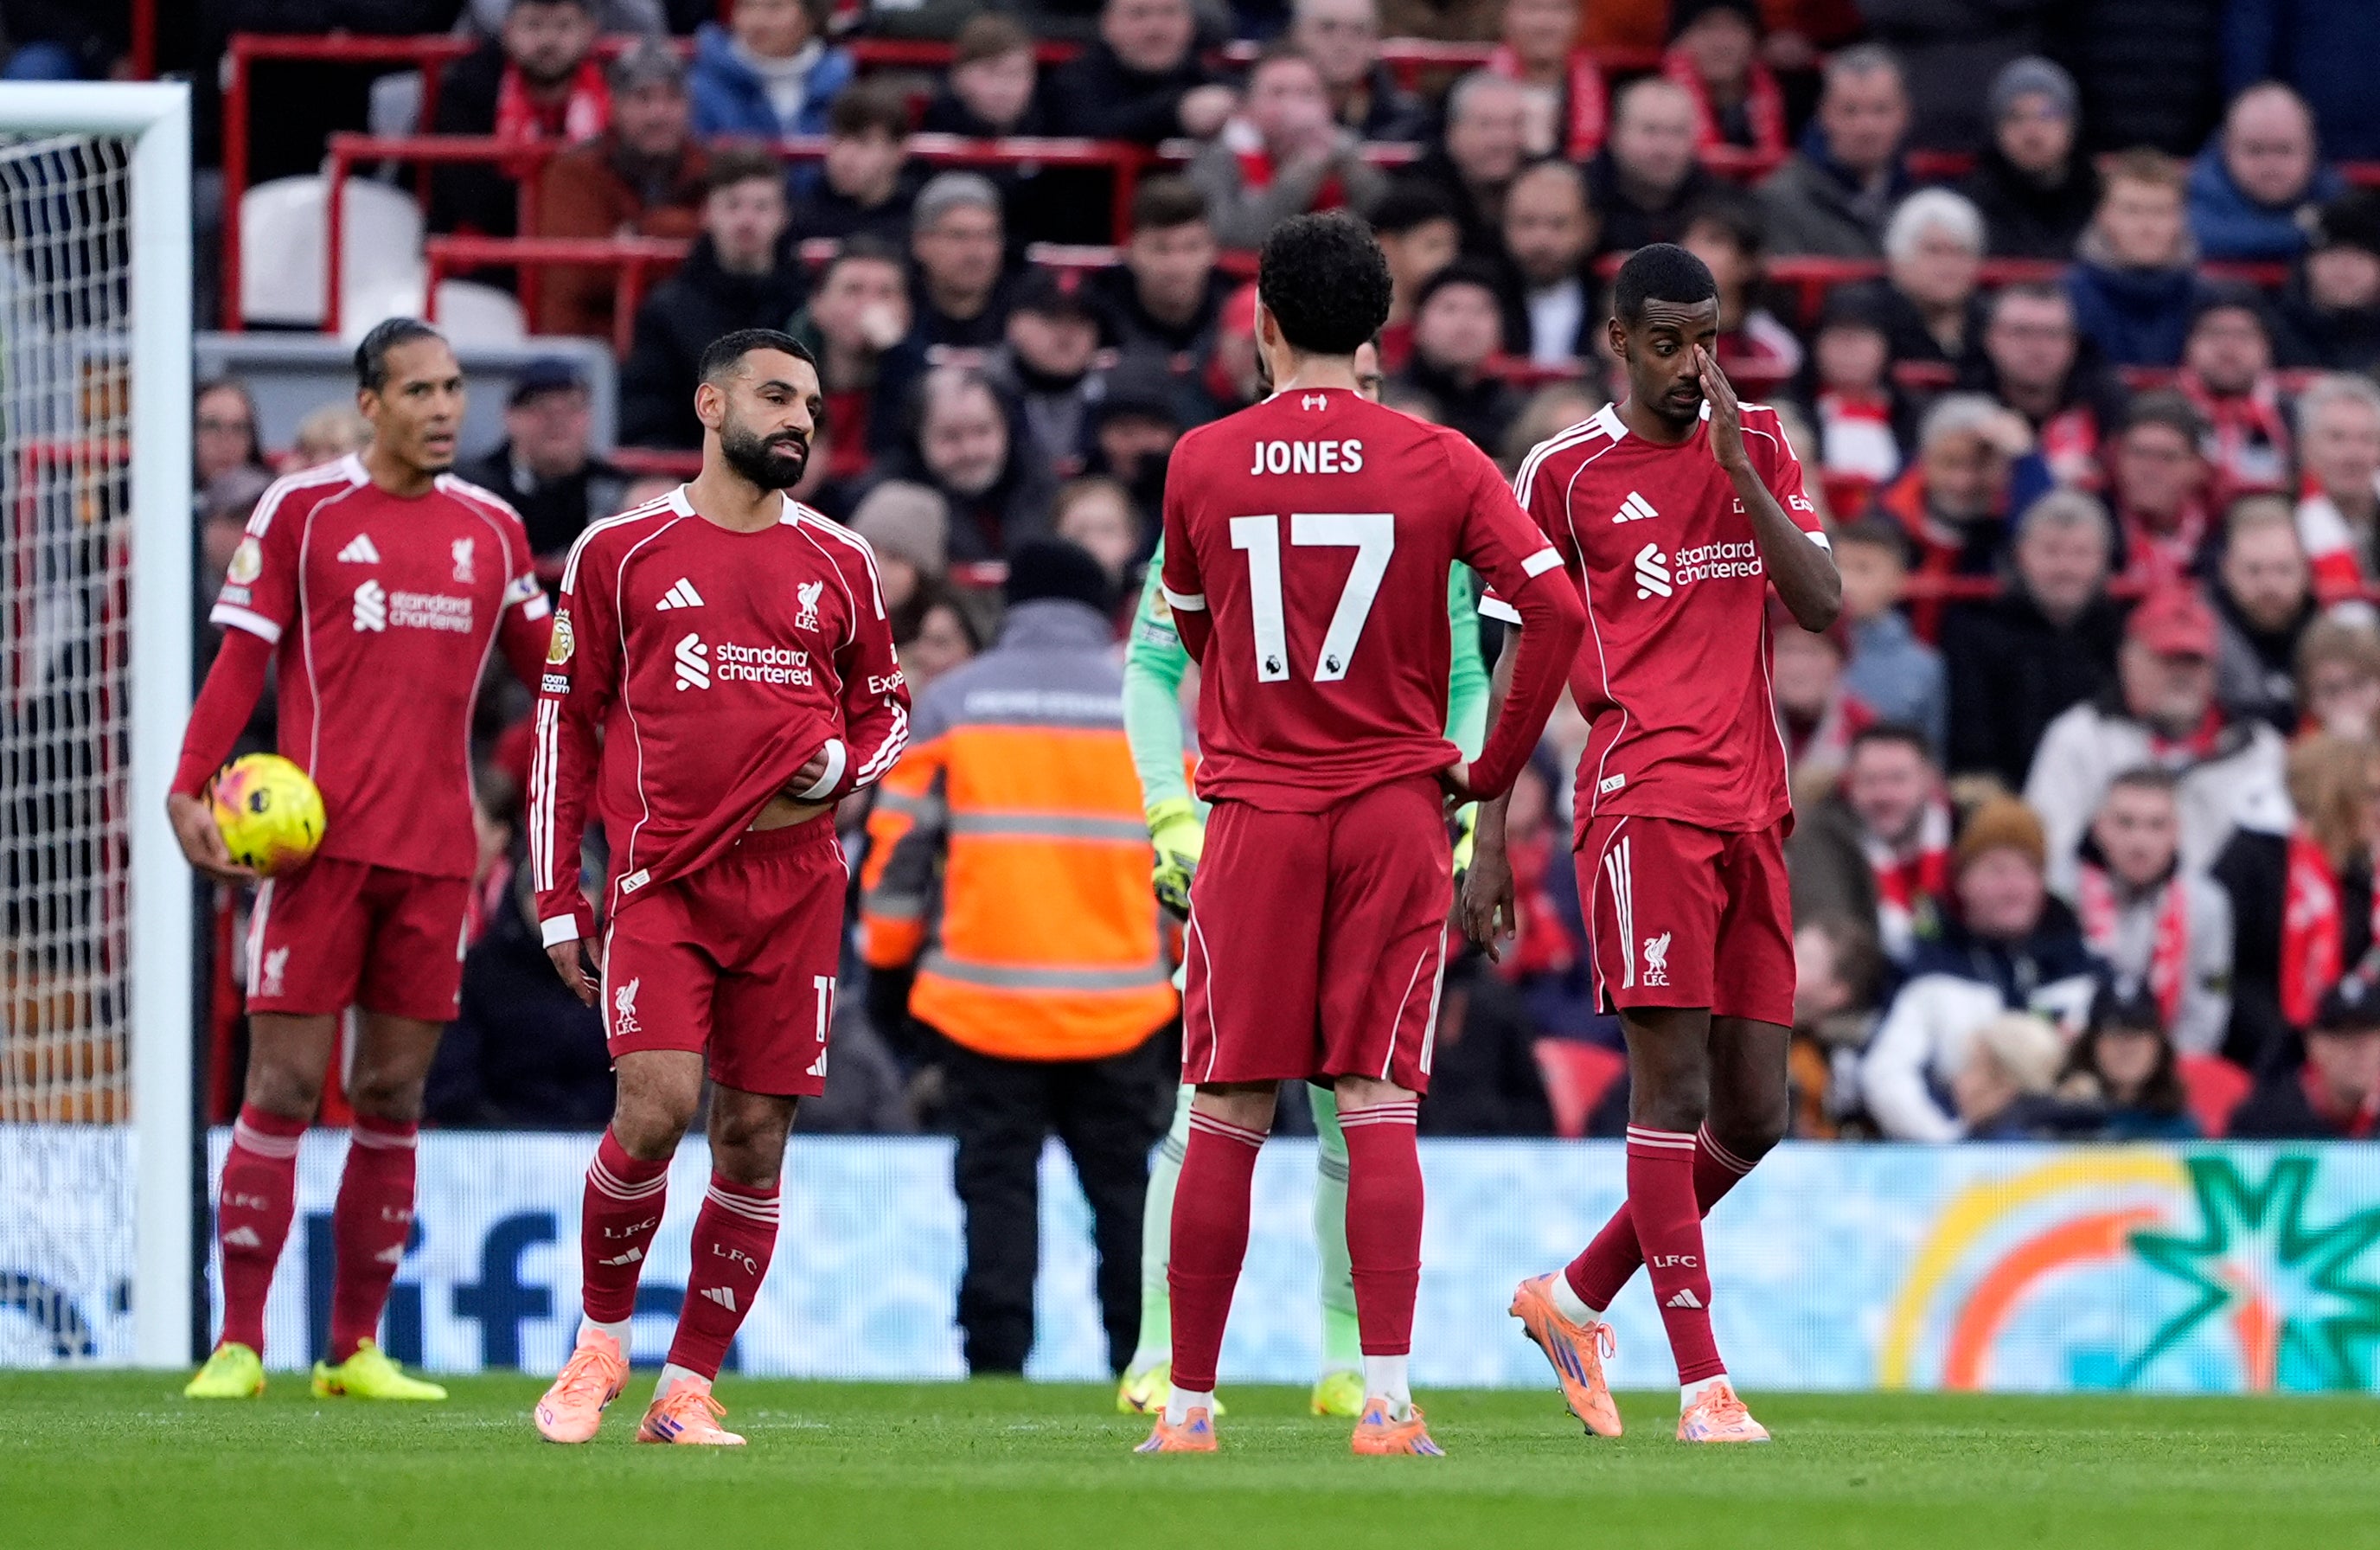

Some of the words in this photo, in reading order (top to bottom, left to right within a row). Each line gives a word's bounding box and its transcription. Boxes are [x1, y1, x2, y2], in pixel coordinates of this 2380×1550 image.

[1251, 439, 1364, 476] JONES
[1675, 539, 1756, 567] standard
[1675, 557, 1763, 586] chartered
[1229, 512, 1395, 683] 17
[716, 641, 809, 667] standard
[717, 663, 813, 687] chartered
[604, 1216, 656, 1239] LFC
[712, 1243, 758, 1276] LFC
[1653, 1254, 1698, 1268] LFC
